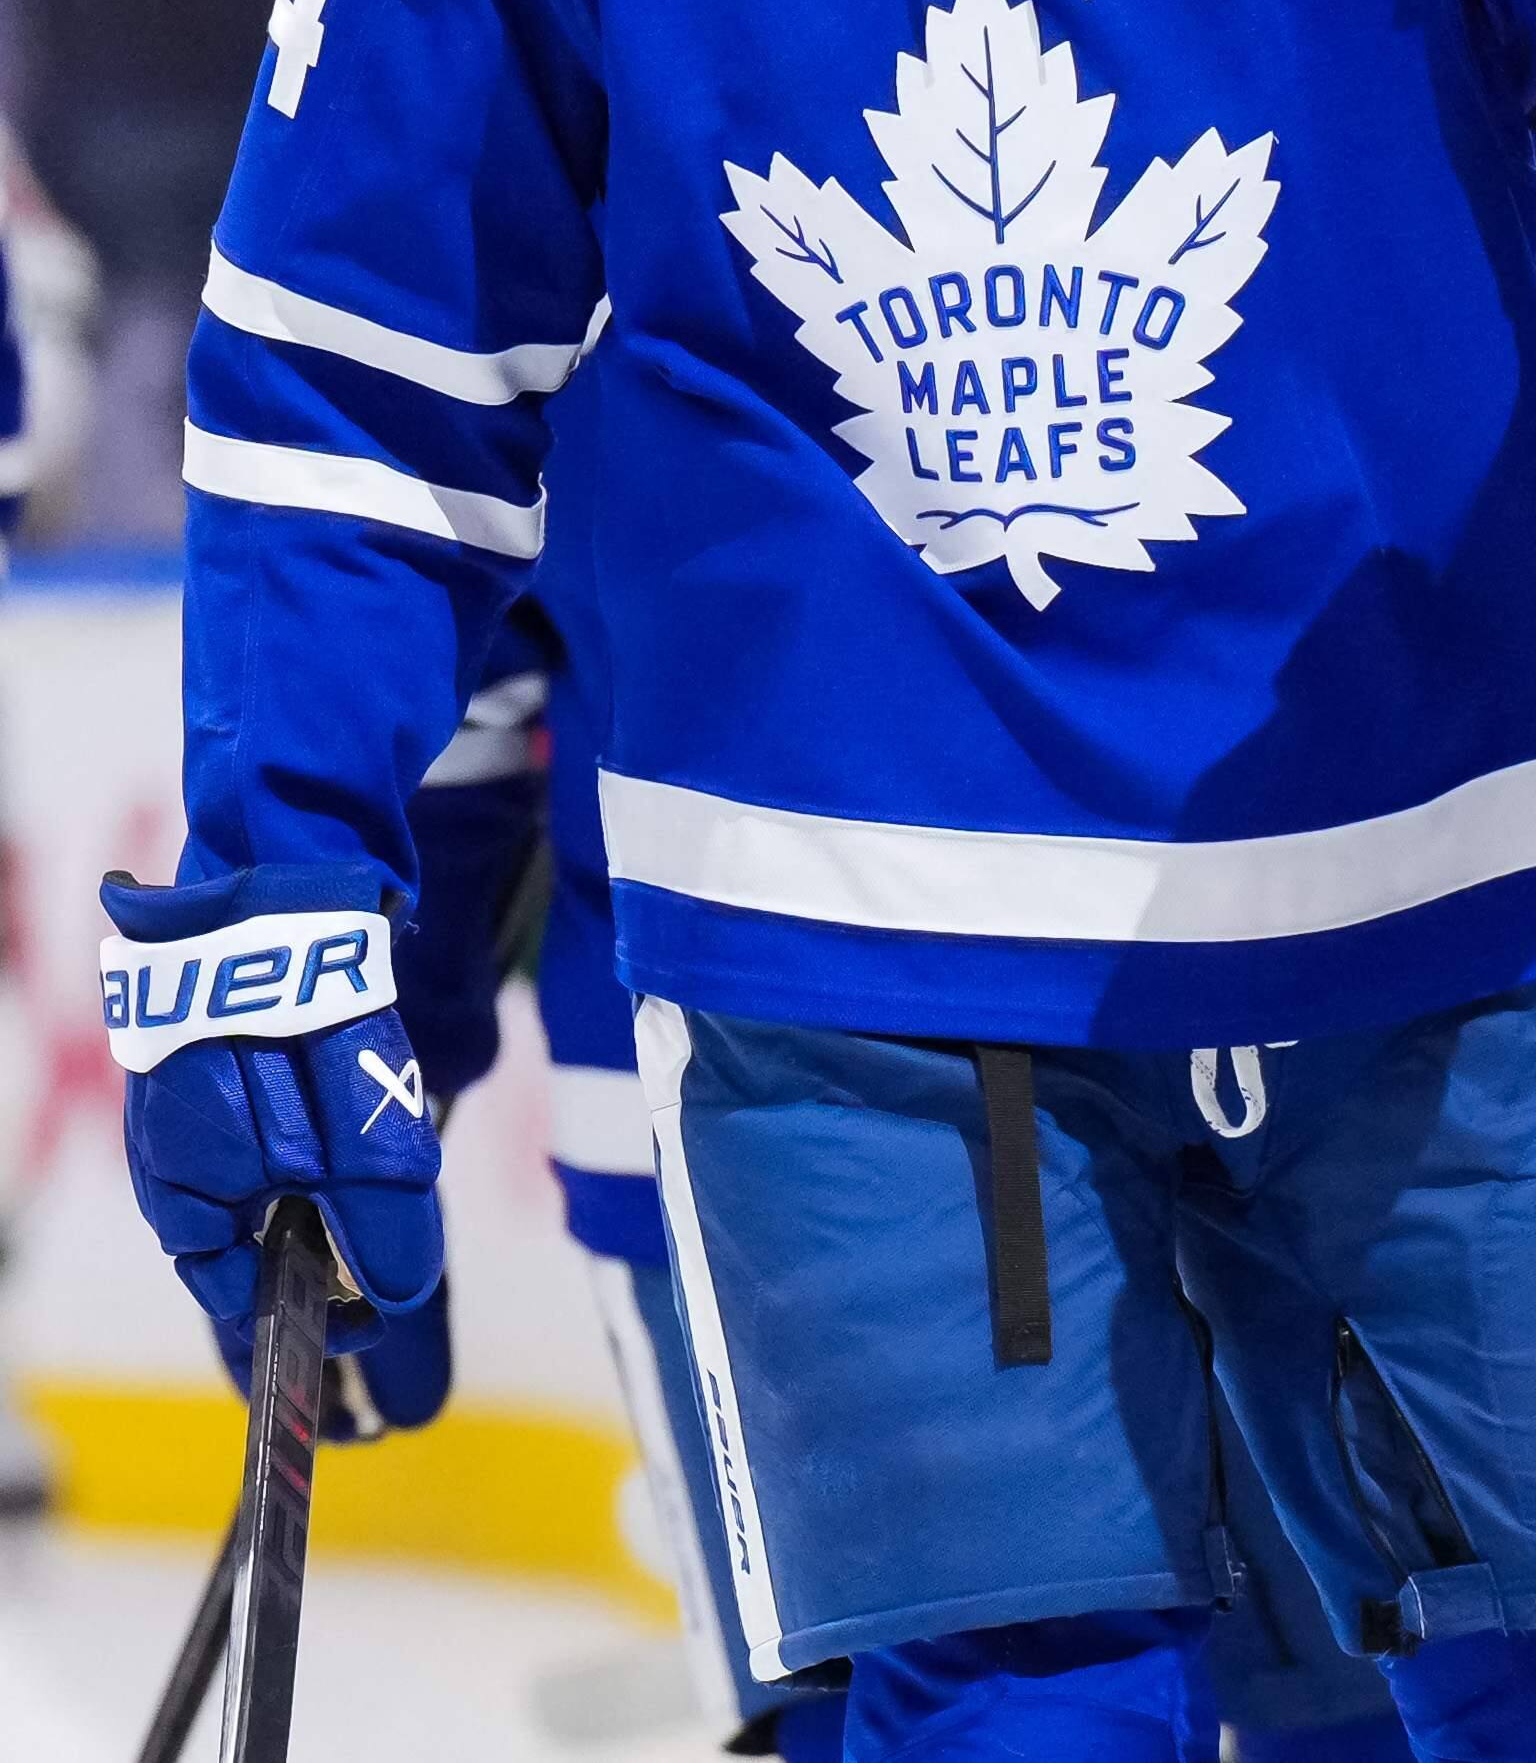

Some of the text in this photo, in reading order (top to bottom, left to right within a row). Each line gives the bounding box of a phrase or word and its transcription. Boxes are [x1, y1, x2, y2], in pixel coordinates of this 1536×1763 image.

[835, 263, 1187, 364] TORONTO
[896, 347, 1133, 416] MAPLE
[906, 417, 1137, 484] LEAFS
[101, 928, 369, 1029] AUER
